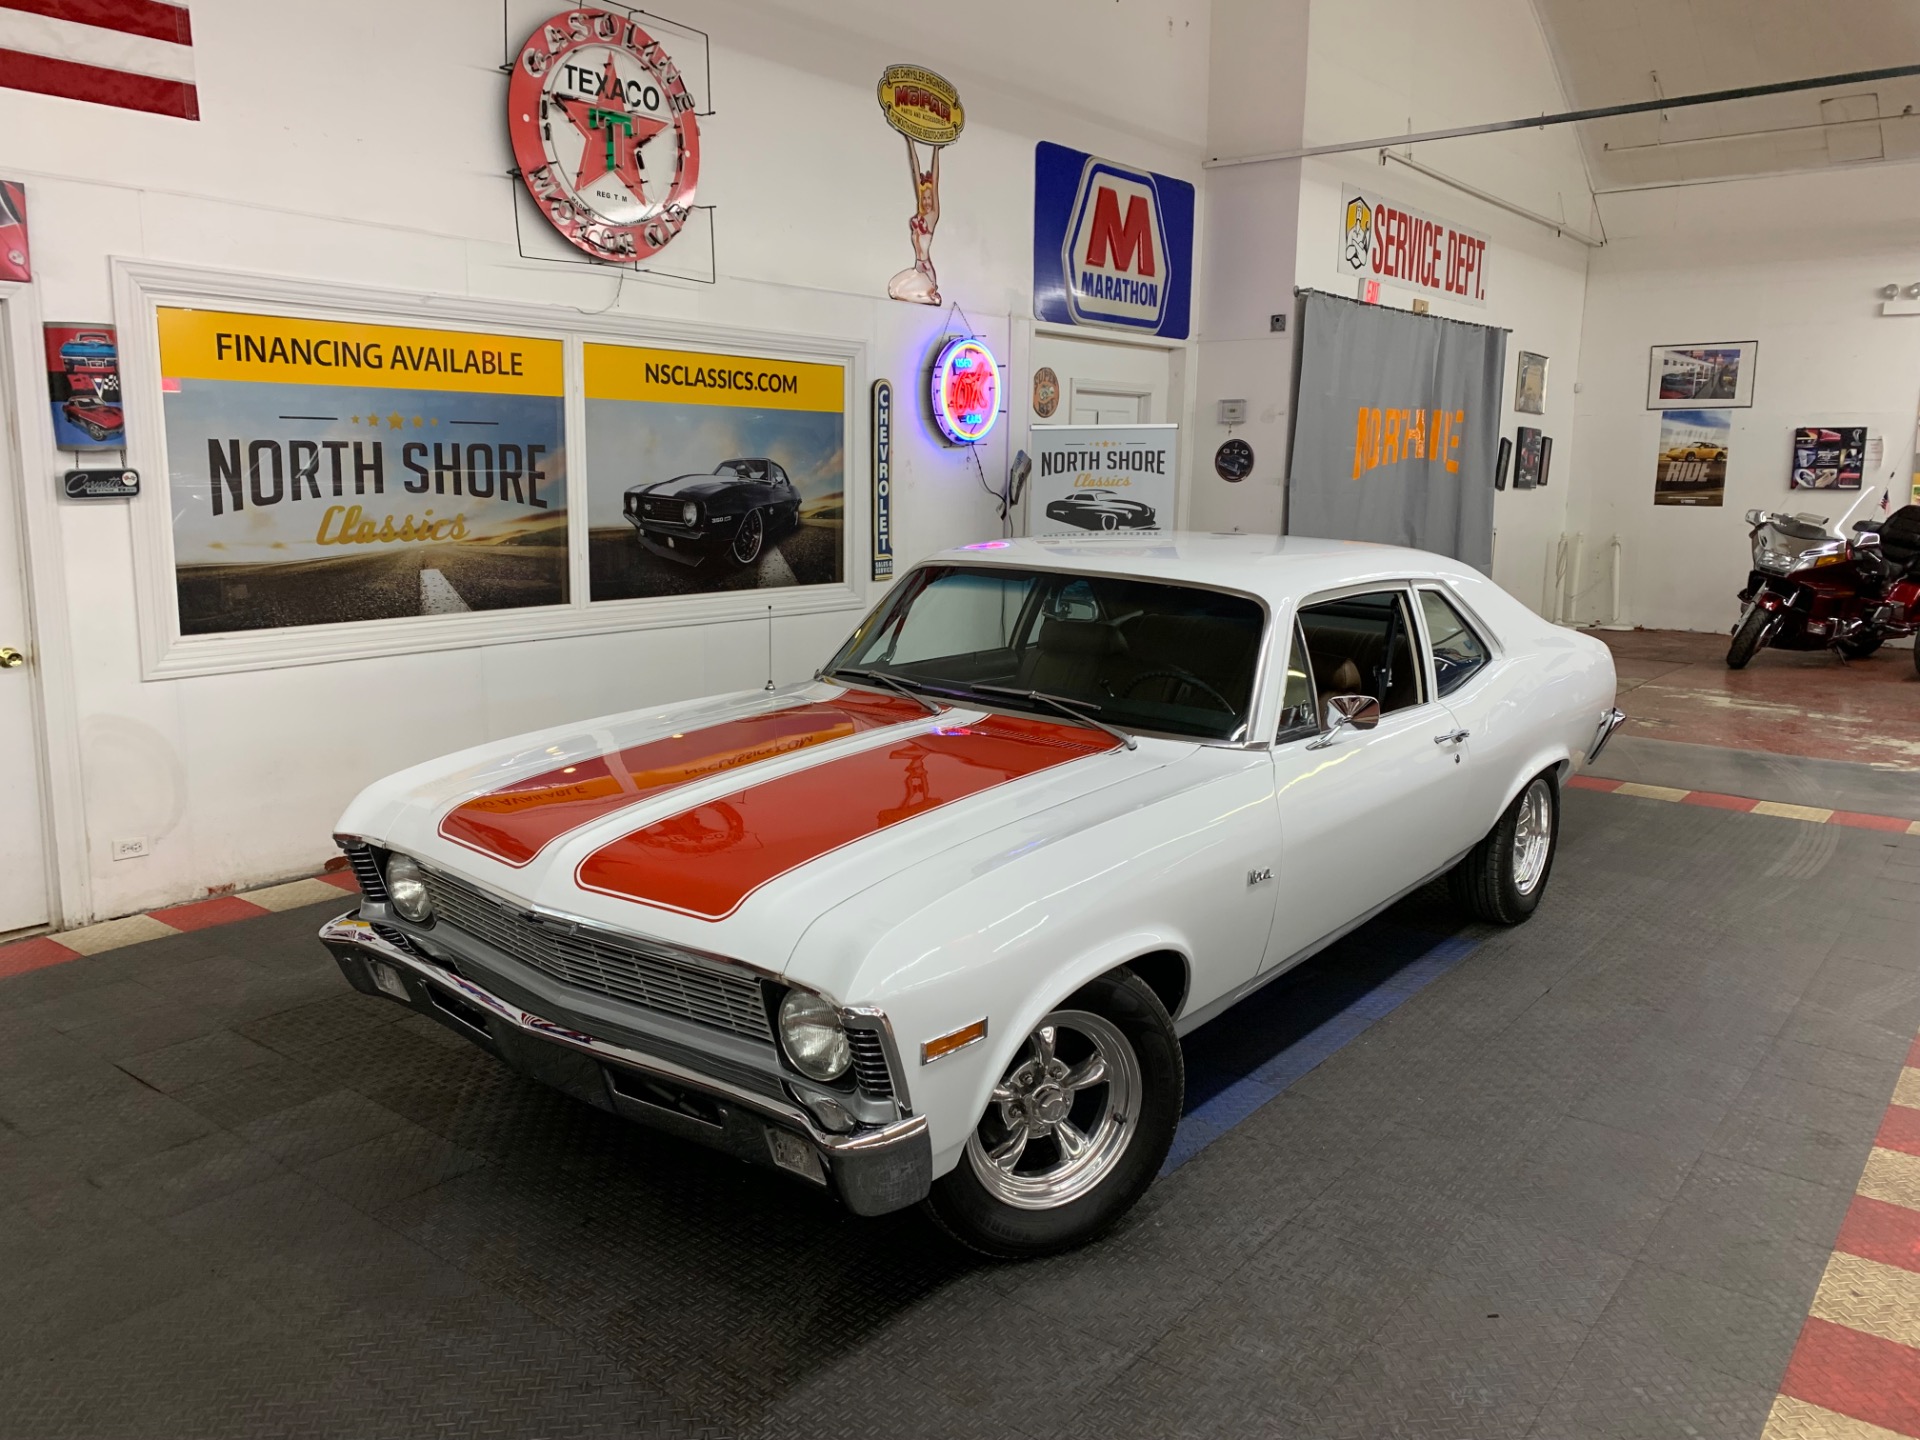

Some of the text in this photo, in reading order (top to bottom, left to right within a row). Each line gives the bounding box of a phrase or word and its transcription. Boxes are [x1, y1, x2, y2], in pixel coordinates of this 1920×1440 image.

[522, 12, 695, 113] GASOLINE
[890, 69, 900, 79] USE
[901, 69, 926, 82] CHRYSLER
[564, 64, 660, 111] TEXACO
[894, 85, 951, 124] MOPAR
[901, 107, 913, 117] PARTS
[913, 111, 921, 119] AND
[596, 190, 628, 203] REG T M
[1086, 186, 1155, 277] M
[1372, 203, 1486, 300] SERVICE DEPT.
[1081, 271, 1158, 308] MARATHON
[1366, 280, 1380, 304] EXIT
[215, 332, 523, 377] FINANCING AVAILABLE
[645, 363, 798, 394] NSCLASSICS.COM
[1041, 450, 1166, 477] NORTH SHORE
[1222, 448, 1249, 456] GTO
[67, 474, 124, 494] Corvette
[207, 437, 548, 517] NORTH SHORE
[878, 390, 890, 551] CHEVROLET
[1073, 472, 1132, 488] Classics
[1665, 461, 1710, 482] RIDE
[315, 504, 471, 547] Classics
[875, 561, 888, 569] SALES
